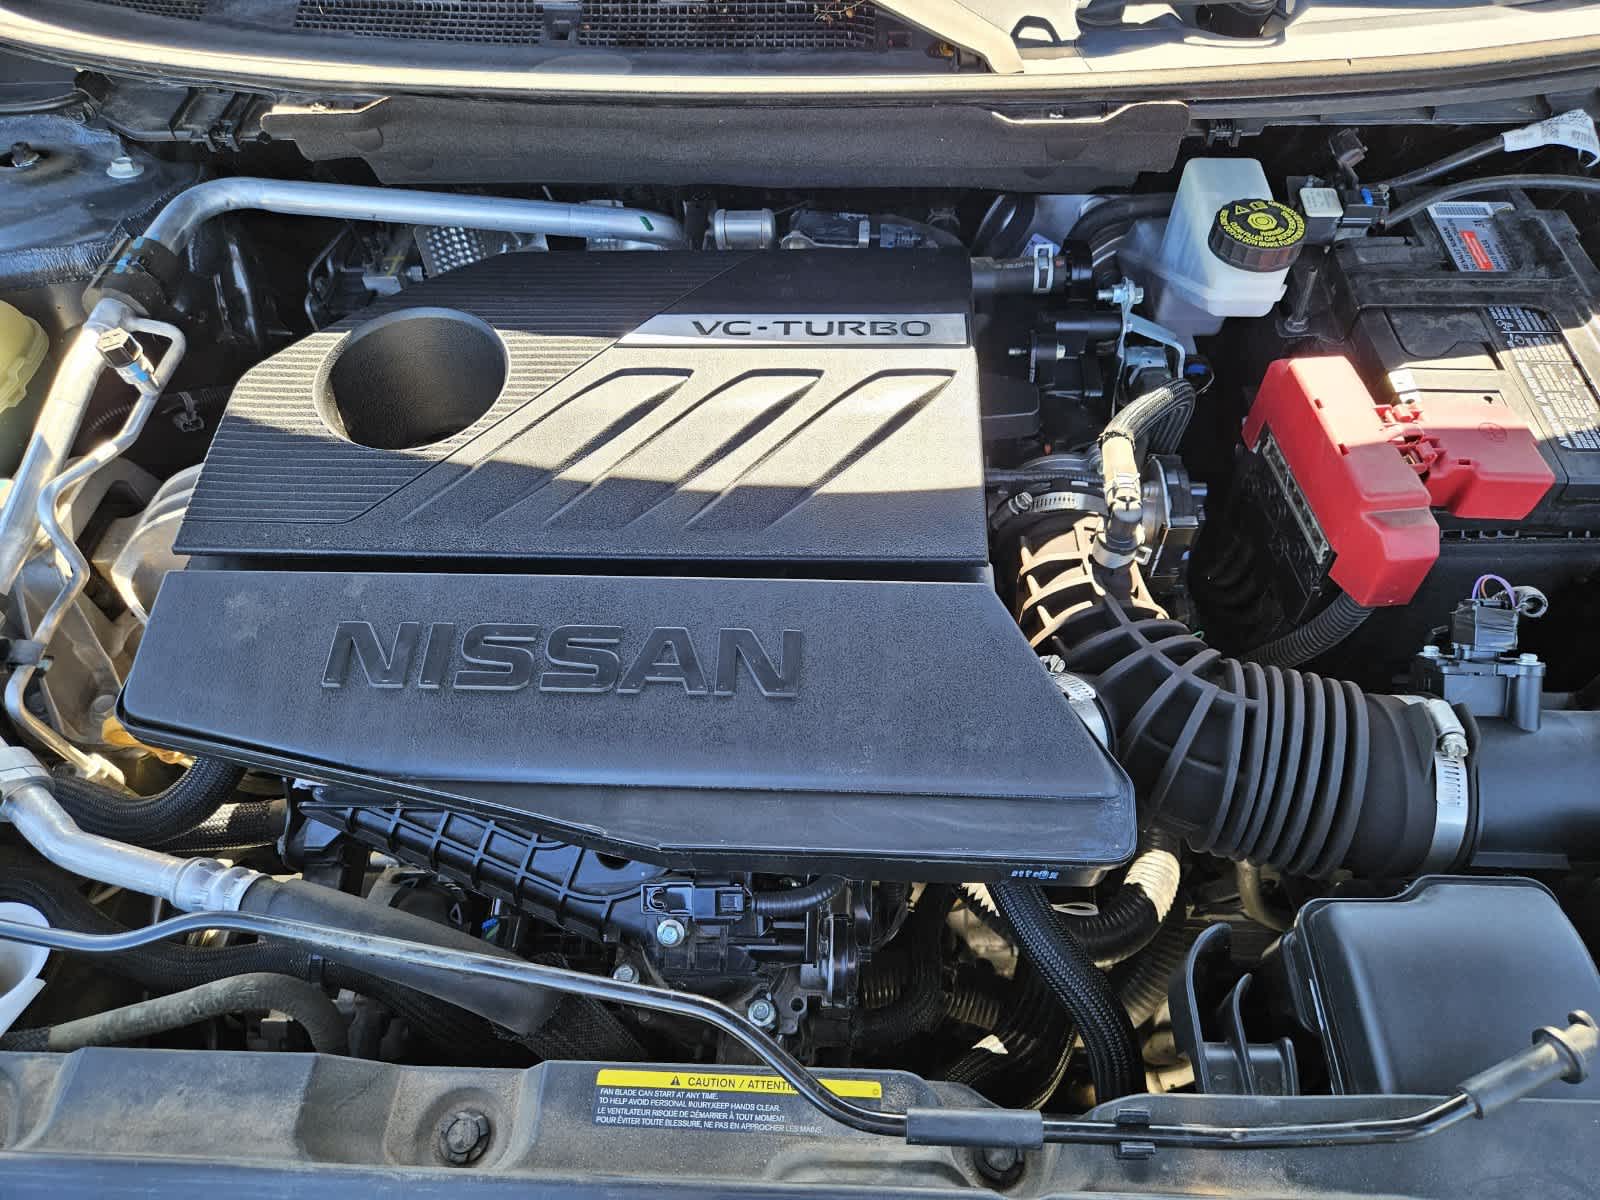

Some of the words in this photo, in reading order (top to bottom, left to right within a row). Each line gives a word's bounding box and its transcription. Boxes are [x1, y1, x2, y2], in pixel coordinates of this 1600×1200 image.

[692, 320, 931, 337] VC-TURBO
[321, 621, 801, 699] NISSAN
[688, 1077, 735, 1088] CAUTION
[600, 1087, 613, 1095] FAN
[615, 1088, 637, 1096] BLADE
[638, 1089, 653, 1097] CAN
[654, 1090, 674, 1098] START
[650, 1099, 686, 1107] PERSONAL
[730, 1103, 755, 1111] HANDS
[598, 1106, 606, 1114] LE
[608, 1107, 651, 1116] VENTILATEUR
[652, 1109, 678, 1117] RISQUE
[680, 1110, 688, 1118] DE
[736, 1113, 752, 1121] TOUT
[596, 1115, 616, 1123] POUR
[642, 1118, 664, 1126] TOUTE
[742, 1123, 784, 1131] APPROCHER
